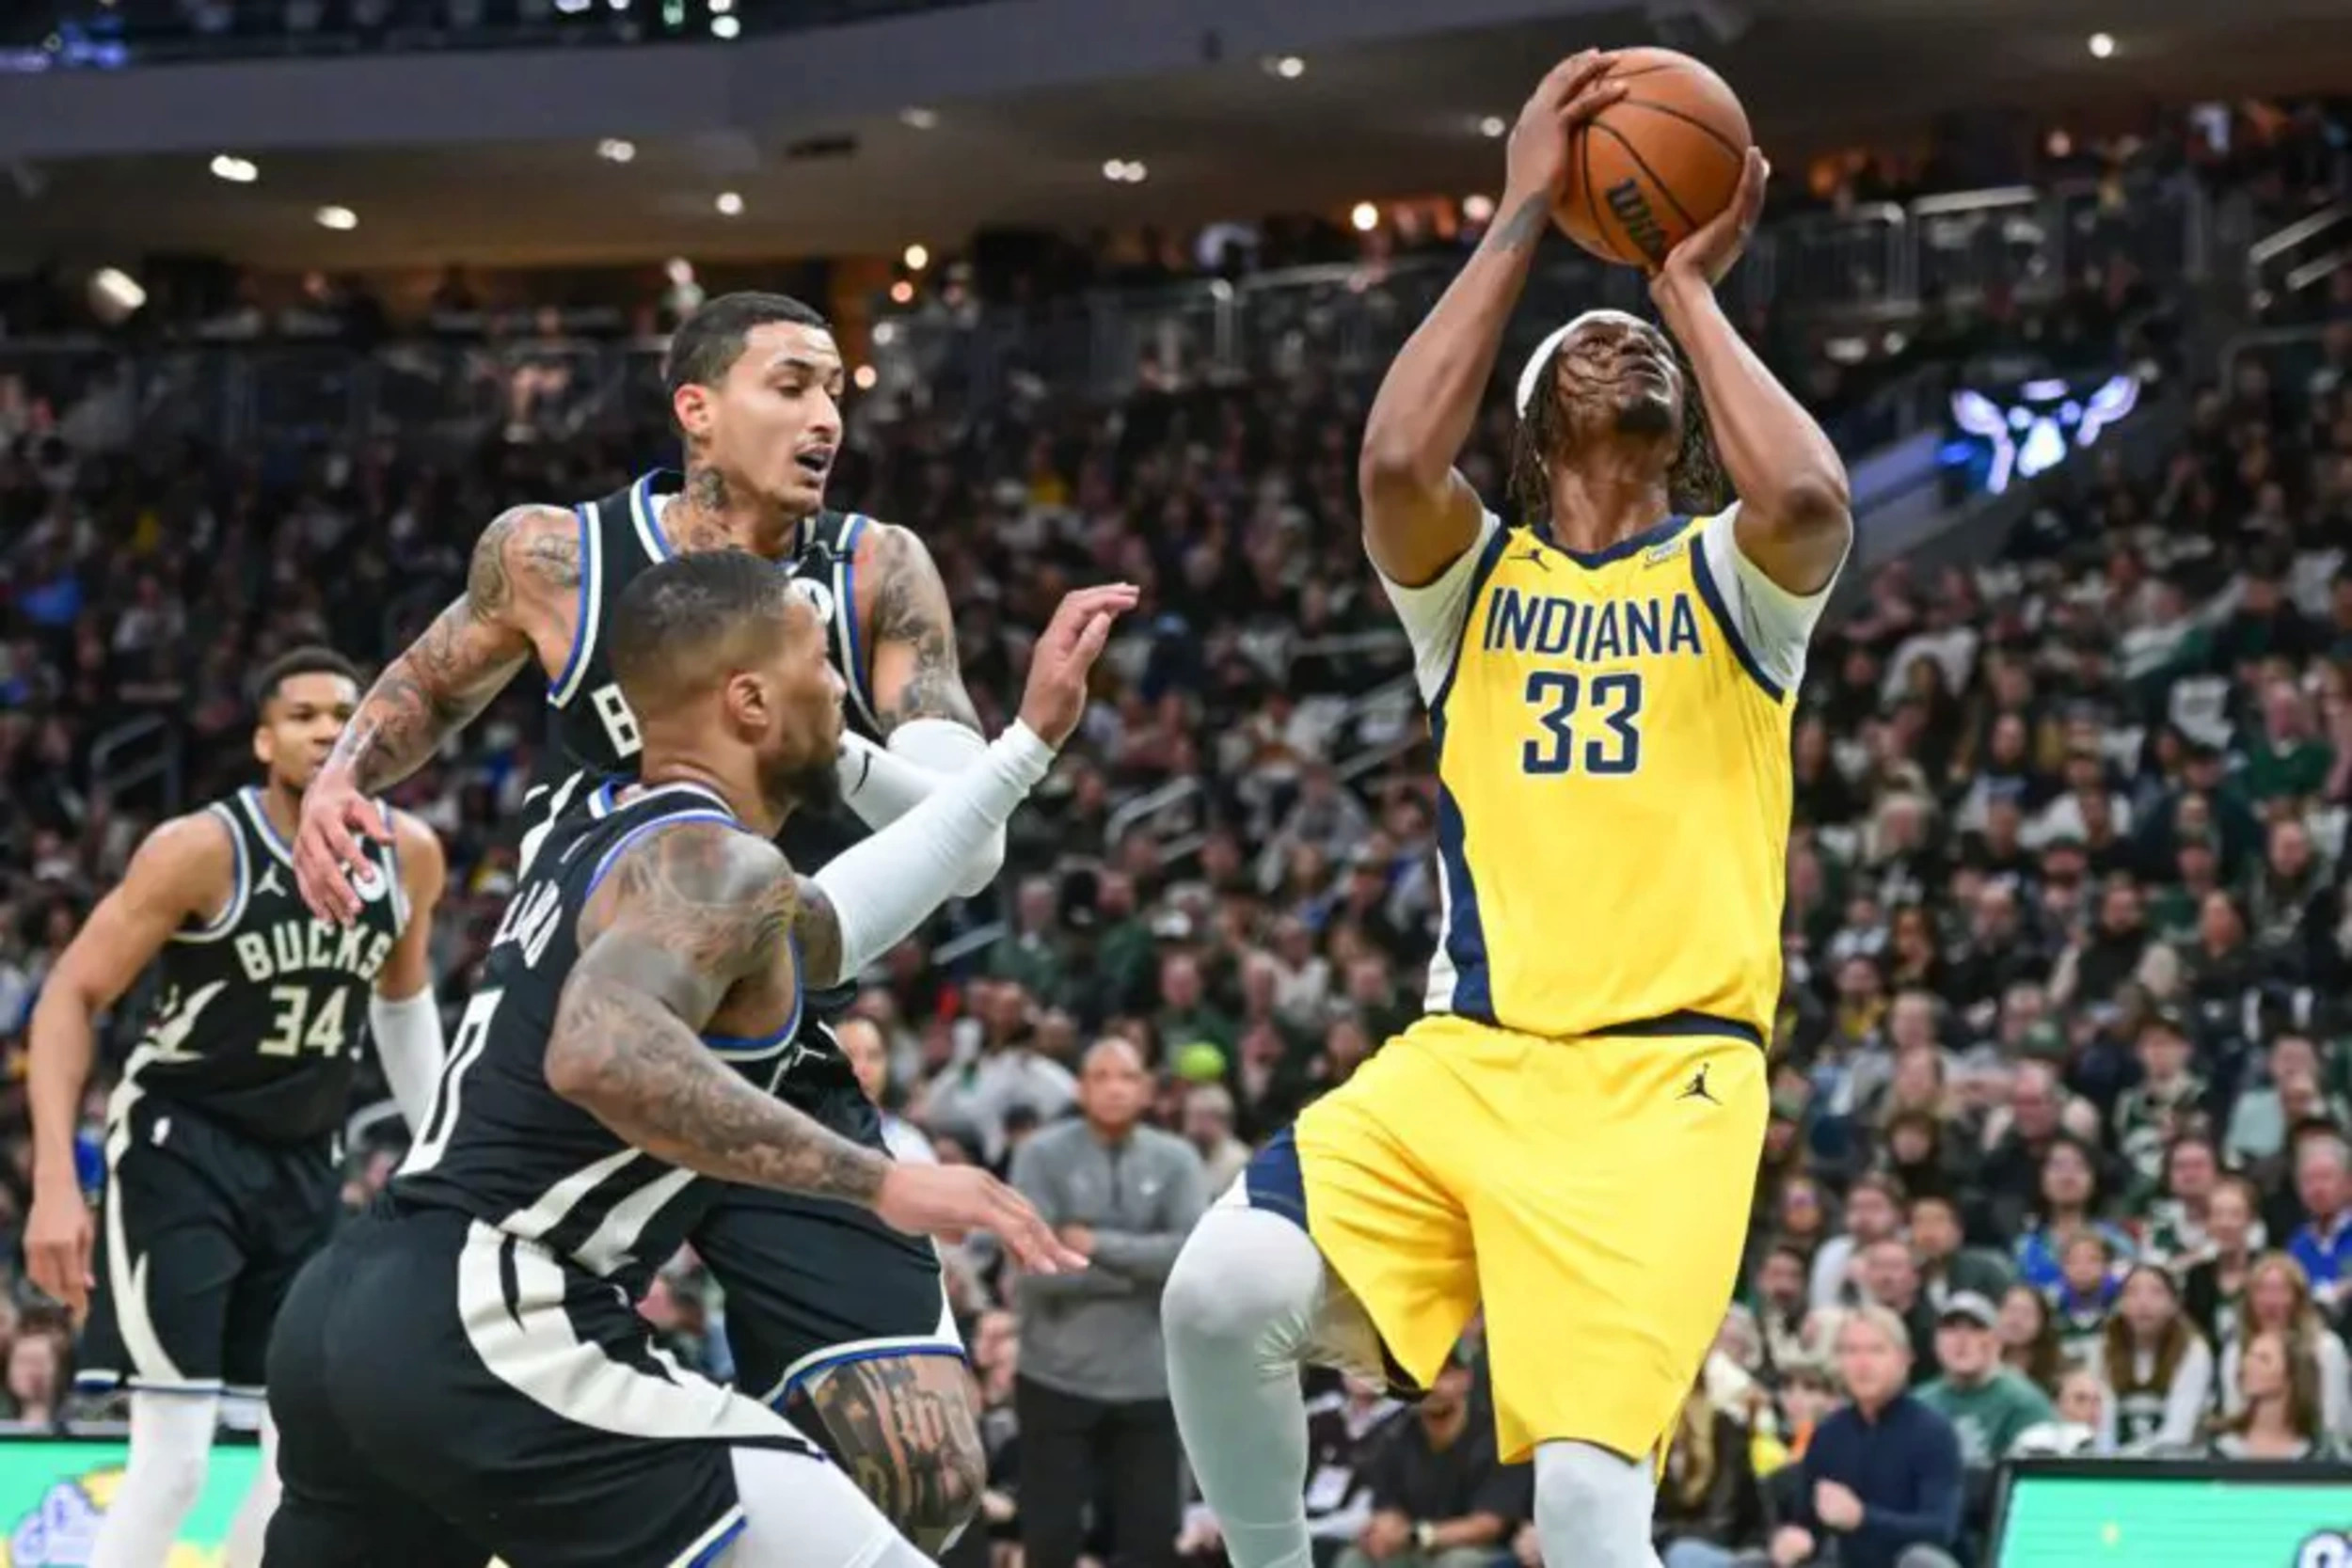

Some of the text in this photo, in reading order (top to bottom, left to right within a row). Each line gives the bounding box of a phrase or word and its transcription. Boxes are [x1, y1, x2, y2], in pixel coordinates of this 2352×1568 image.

[1483, 587, 1703, 662] INDIANA
[1521, 670, 1643, 775] 33
[234, 918, 393, 982] BUCKS
[257, 986, 349, 1057] 34
